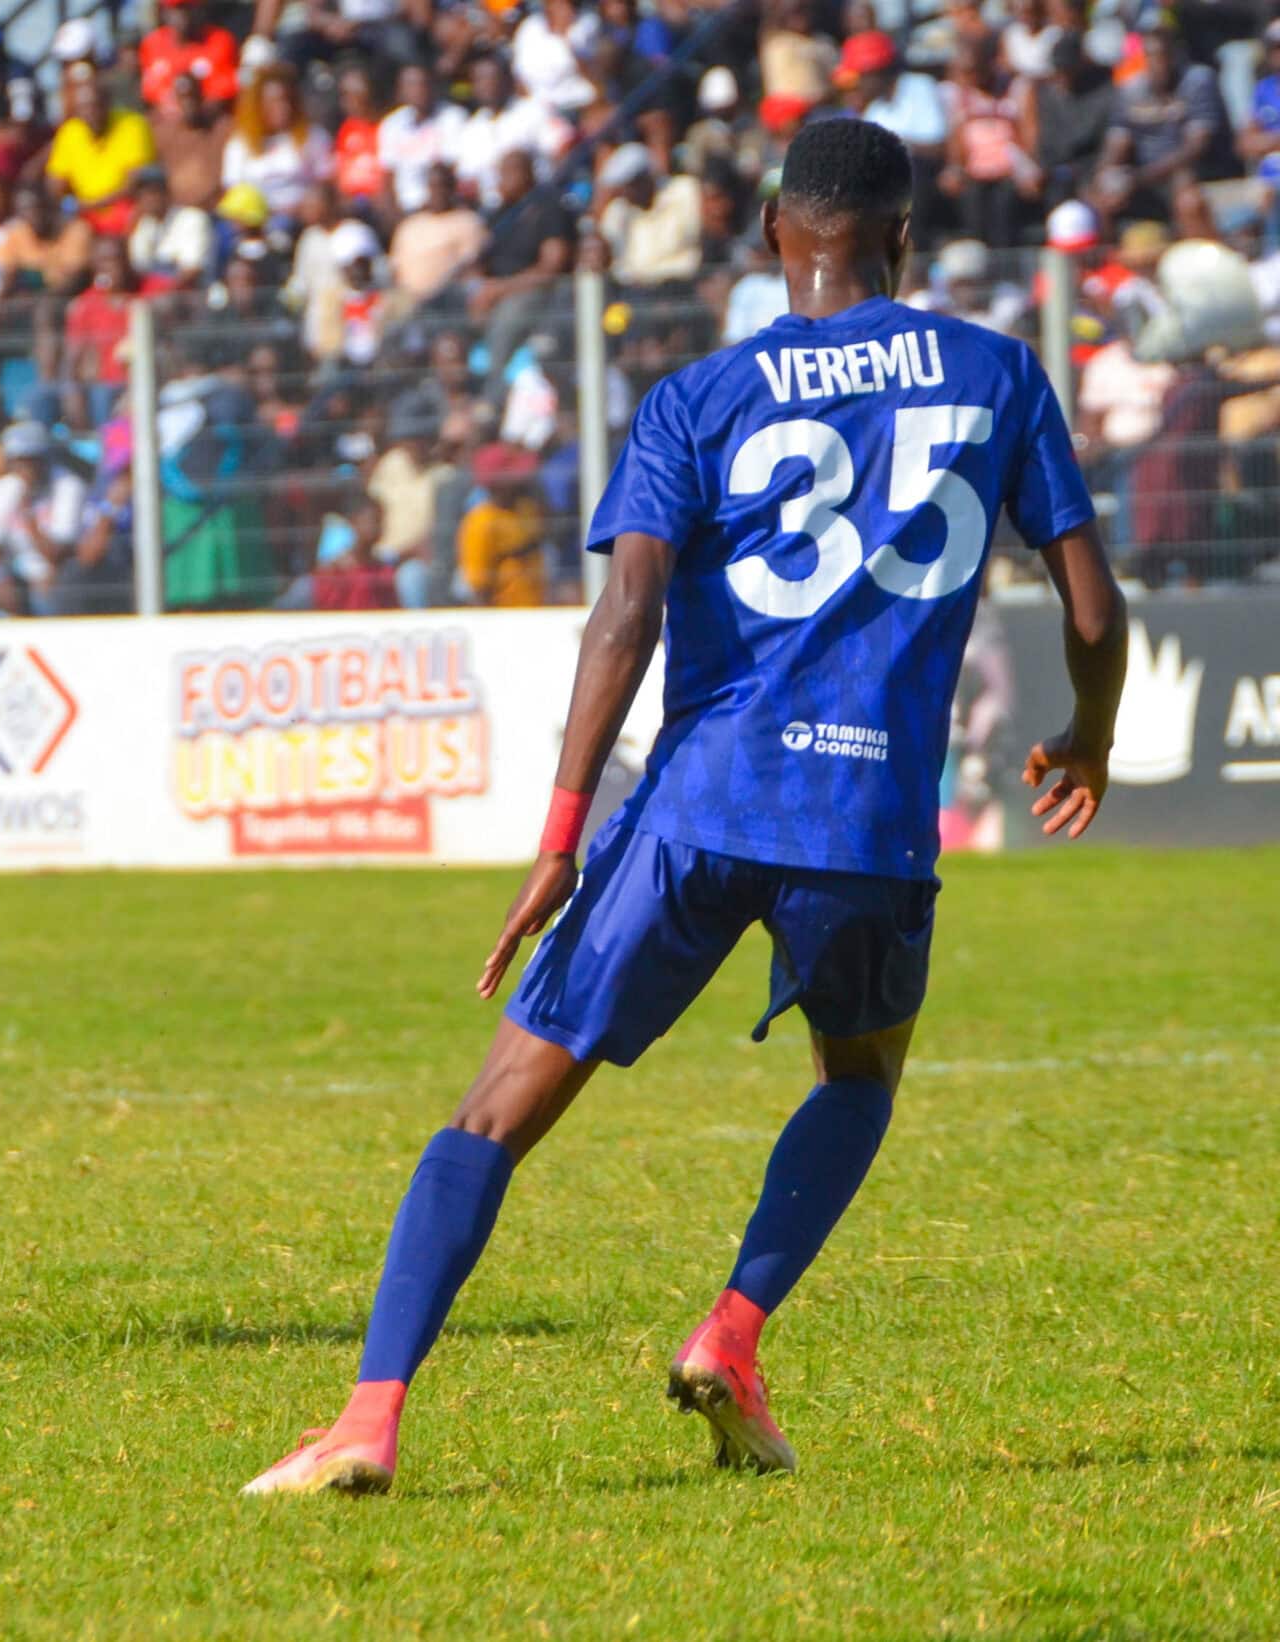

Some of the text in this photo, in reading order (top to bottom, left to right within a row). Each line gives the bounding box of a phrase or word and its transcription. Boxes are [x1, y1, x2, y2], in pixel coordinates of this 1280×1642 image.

[755, 329, 945, 404] VEREMU
[725, 404, 994, 619] 35
[180, 640, 470, 723] FOOTBALL
[178, 725, 373, 803] UNITES
[814, 740, 888, 761] COACHES
[815, 723, 889, 746] TAMUKA
